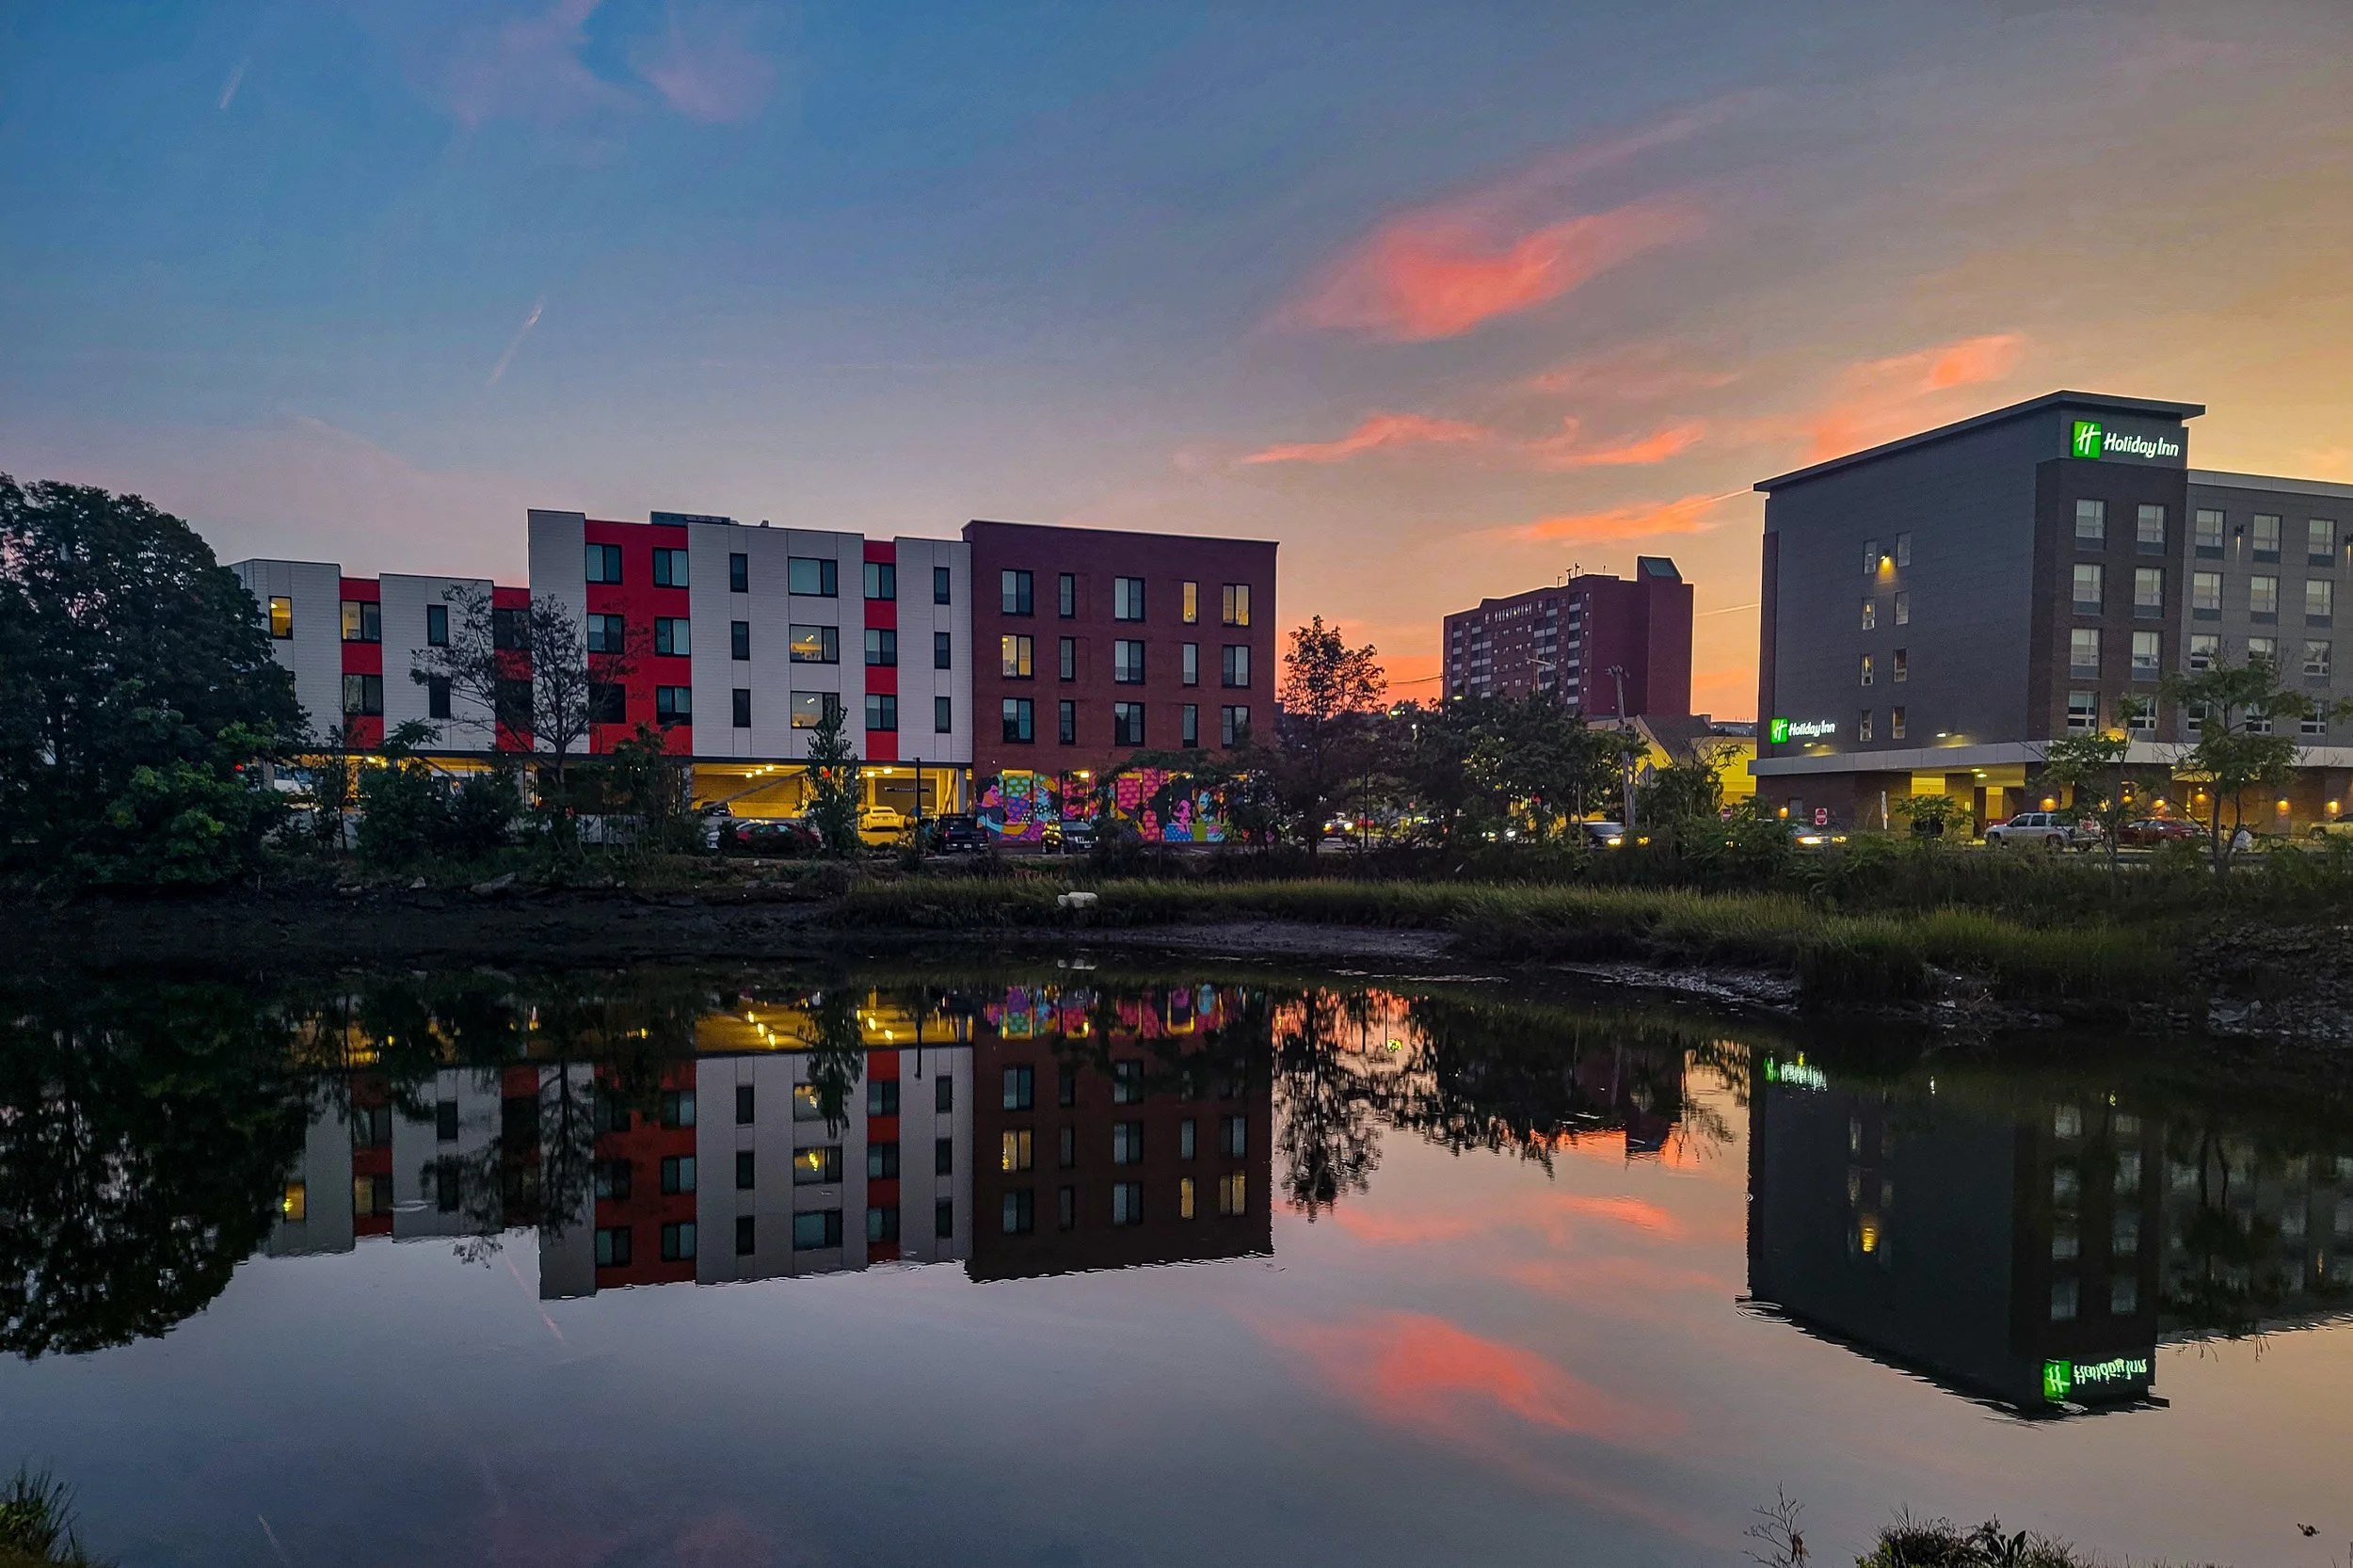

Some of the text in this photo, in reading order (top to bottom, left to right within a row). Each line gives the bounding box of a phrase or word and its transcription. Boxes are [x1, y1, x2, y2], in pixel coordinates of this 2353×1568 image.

[2103, 432, 2157, 458] Holiday
[2157, 437, 2180, 457] Inn
[1788, 721, 1821, 738] Holiday
[1820, 719, 1836, 734] Inn
